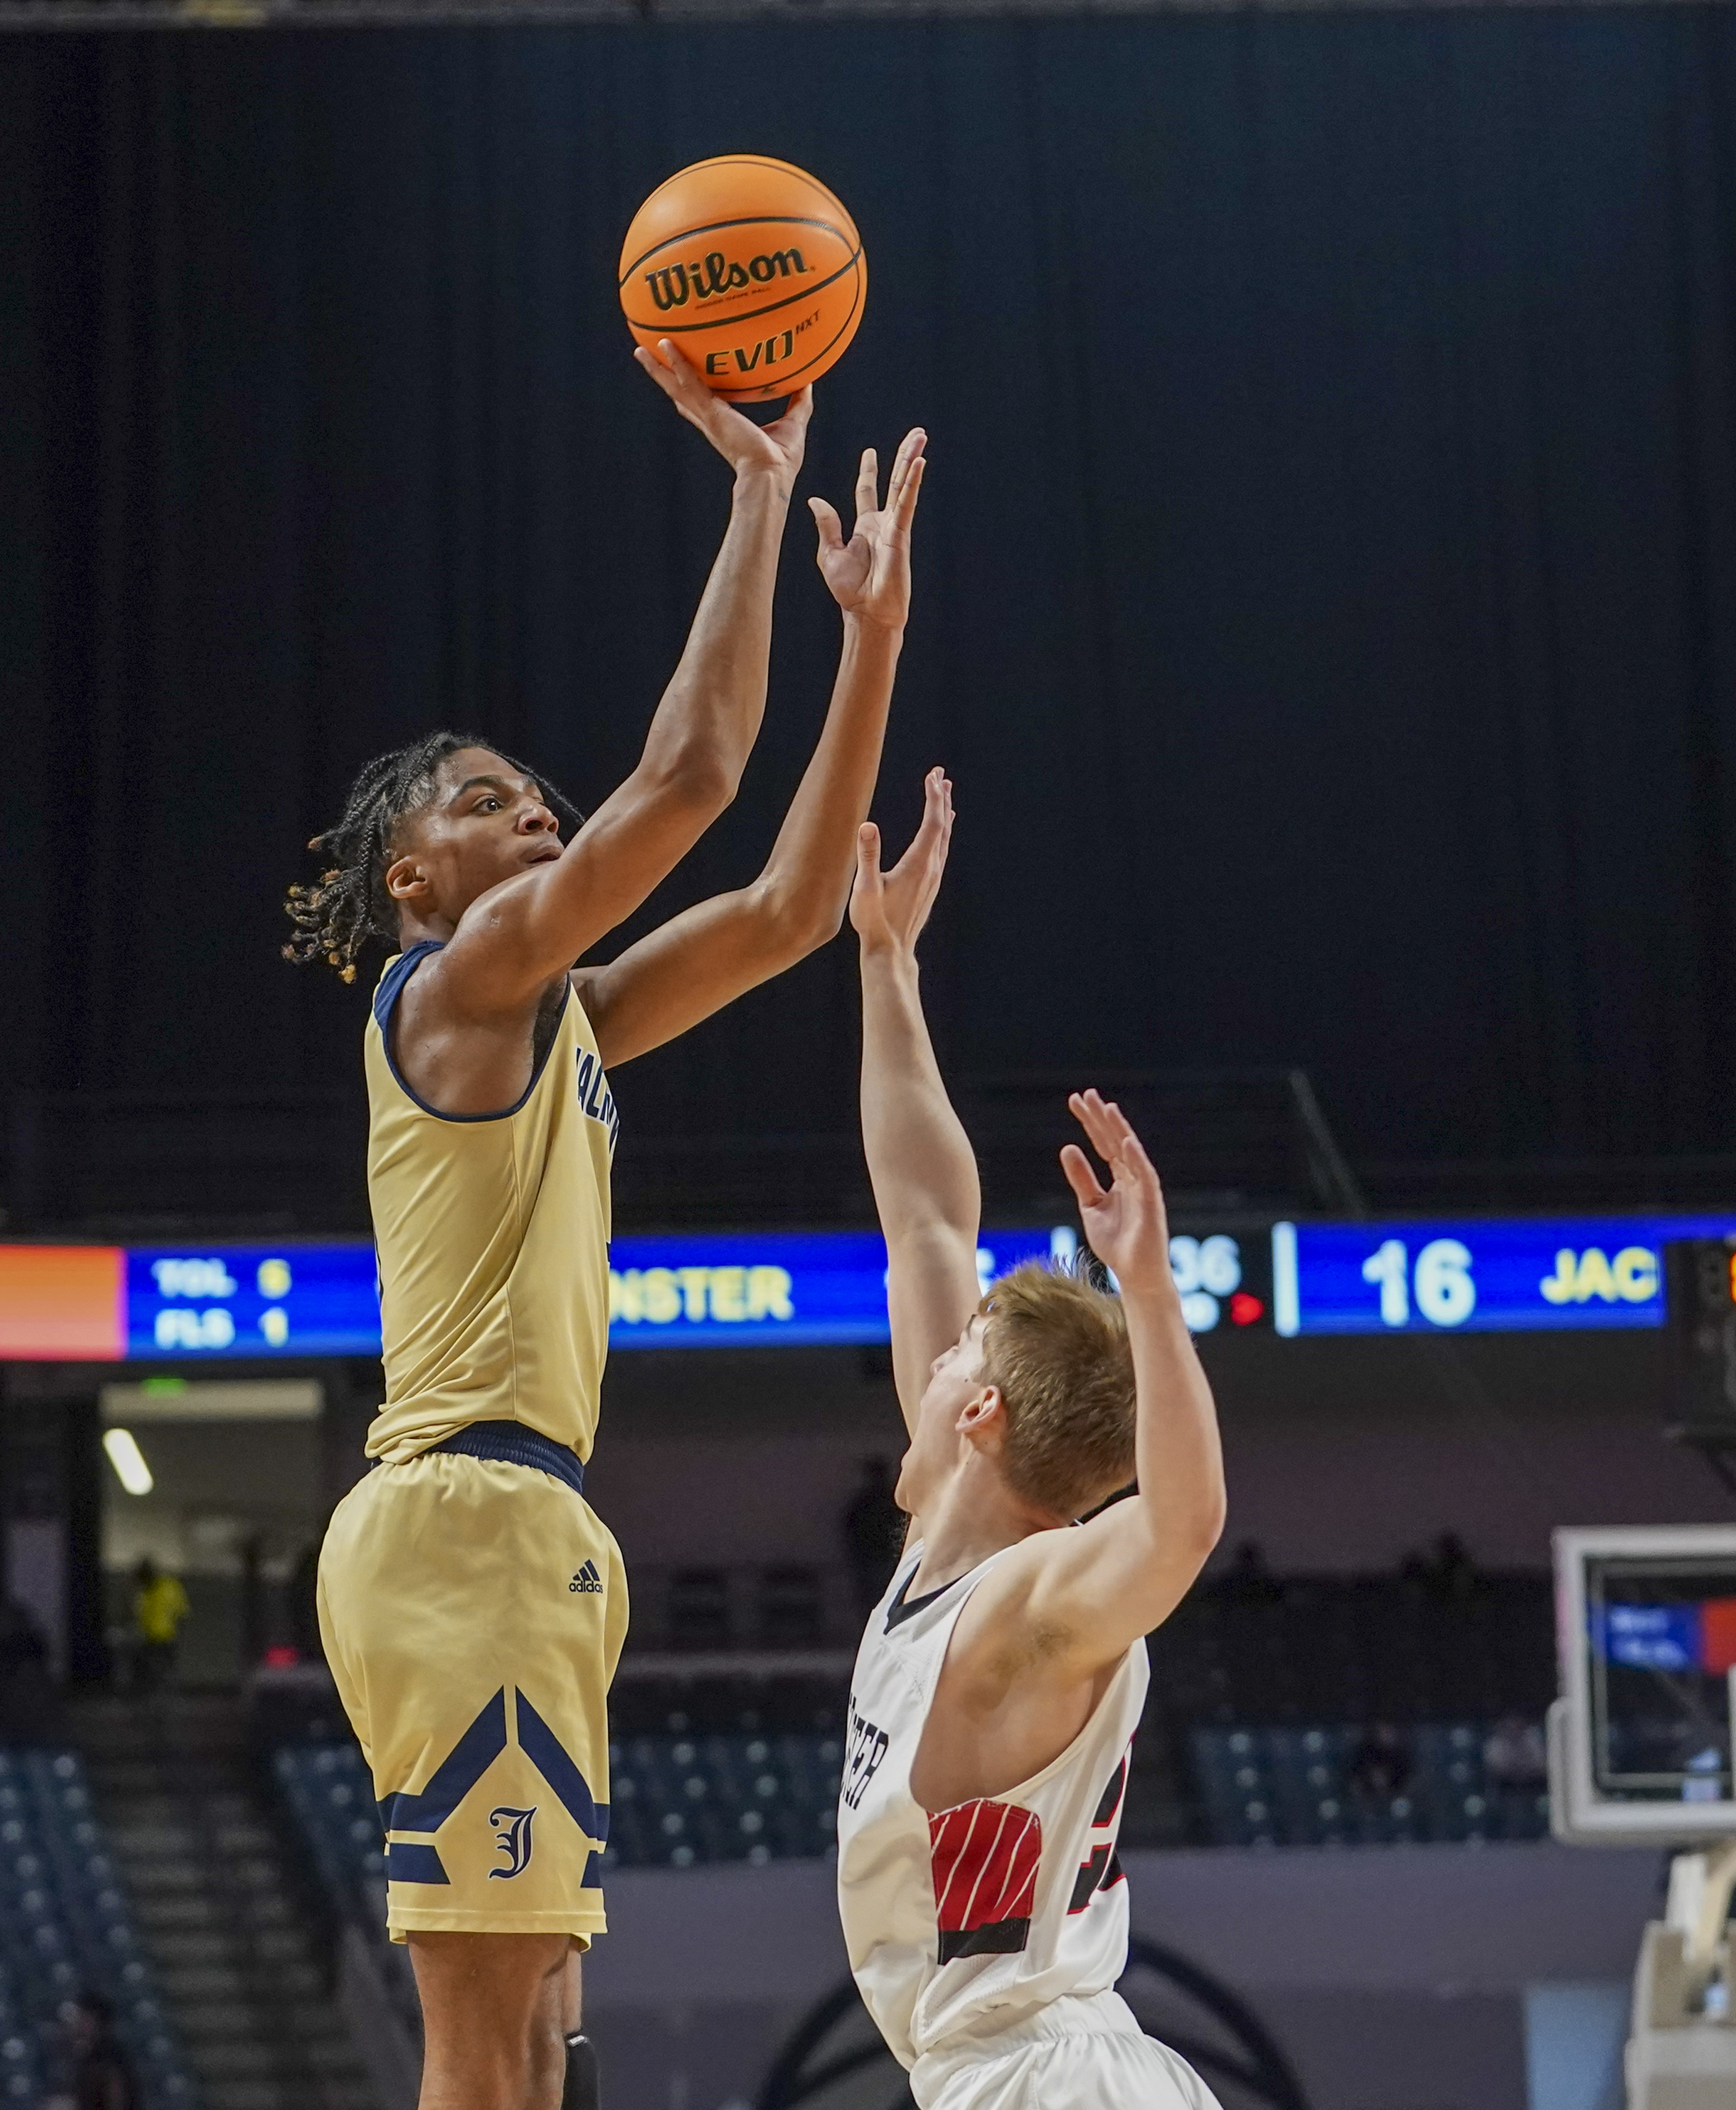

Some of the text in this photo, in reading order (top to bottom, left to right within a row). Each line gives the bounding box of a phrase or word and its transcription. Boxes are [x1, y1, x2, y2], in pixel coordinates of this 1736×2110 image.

[645, 247, 807, 311] Wilson
[1362, 1238, 1477, 1327] 16
[258, 1306, 289, 1348] 1
[569, 1580, 603, 1594] adidas
